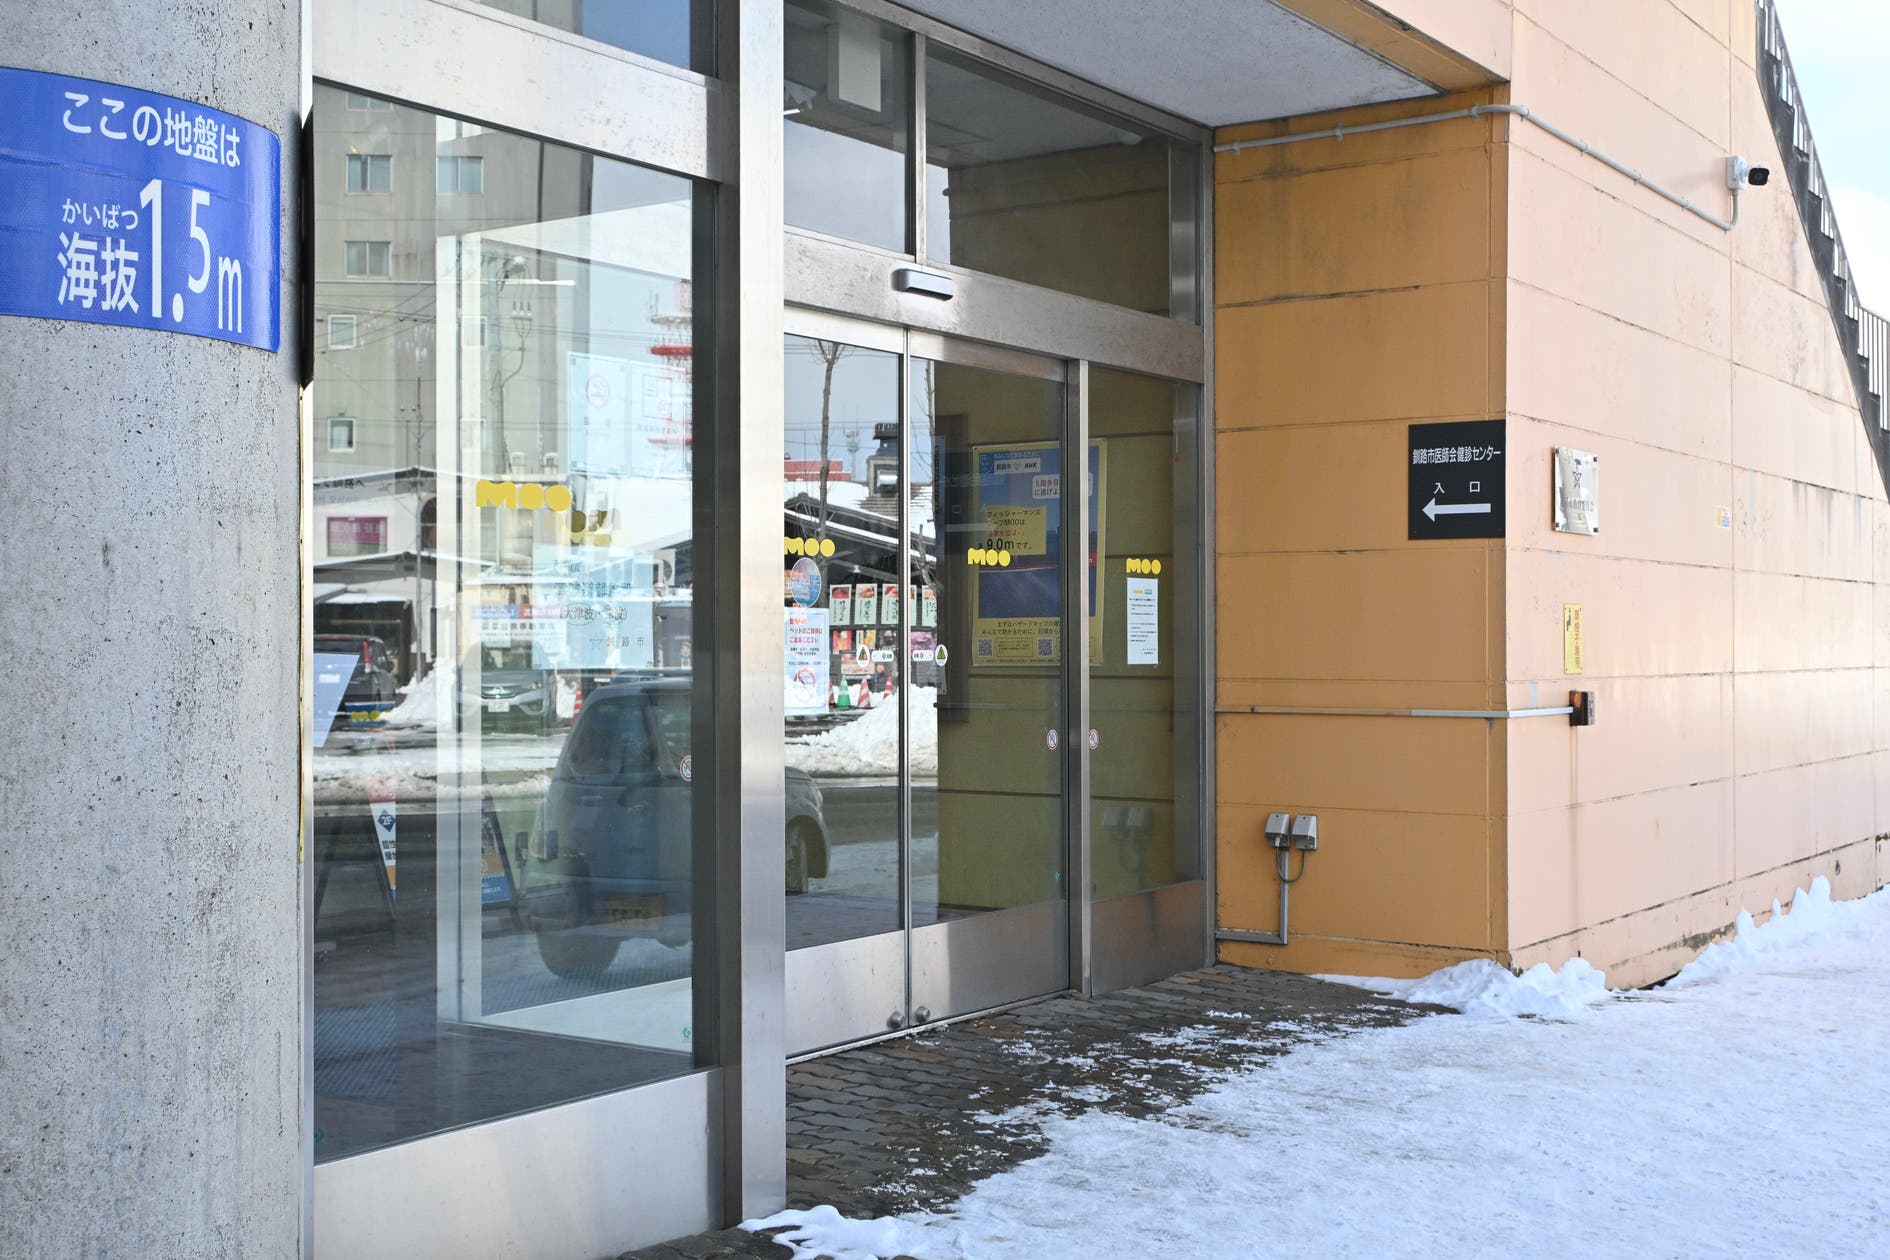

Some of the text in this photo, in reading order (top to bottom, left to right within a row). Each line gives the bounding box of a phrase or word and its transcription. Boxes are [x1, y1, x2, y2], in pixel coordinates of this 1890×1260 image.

[62, 91, 241, 168] ここの地盤は
[61, 198, 139, 230] かいばつ
[1412, 446, 1501, 465] 釧路市医師会健診センター
[476, 479, 571, 512] MOO
[986, 508, 1041, 519] フィッシャーマンズ
[784, 537, 835, 557] MOO
[967, 547, 1011, 567] MOO
[1126, 558, 1162, 575] MOO
[381, 815, 394, 826] 2F
